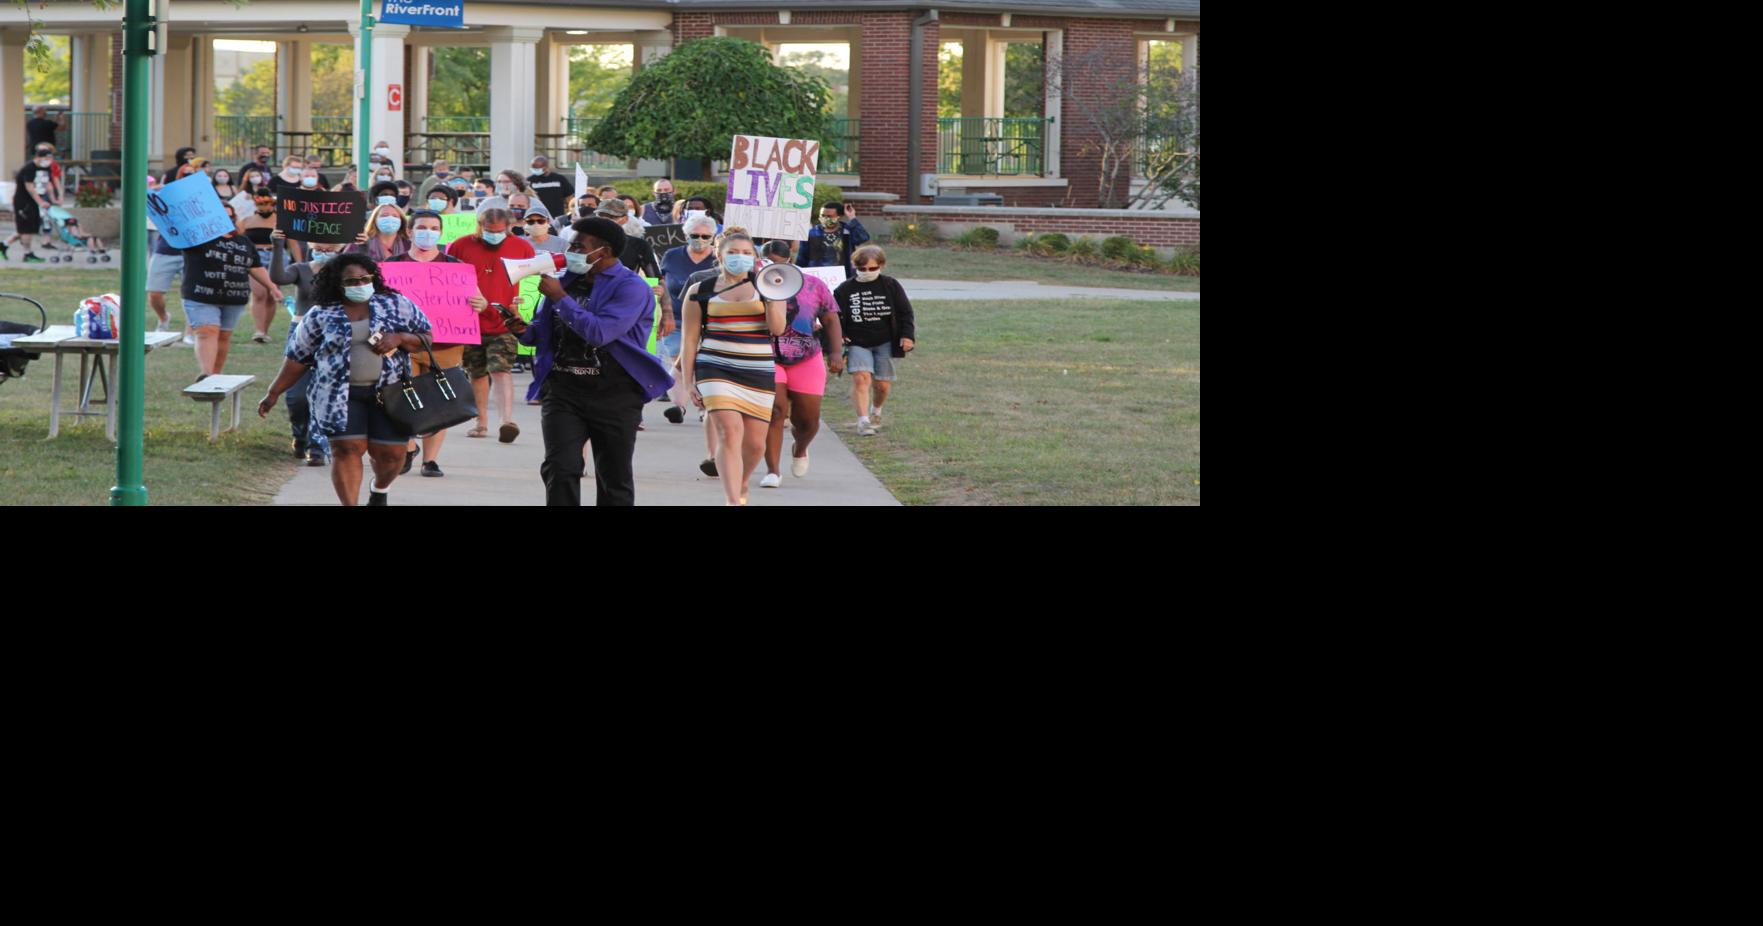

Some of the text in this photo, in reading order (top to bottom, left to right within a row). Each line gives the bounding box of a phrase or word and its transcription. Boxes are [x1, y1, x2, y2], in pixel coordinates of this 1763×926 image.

[385, 3, 460, 16] RiverFront
[388, 88, 401, 106] C
[733, 135, 820, 175] BLACK
[727, 168, 815, 209] LIVES
[283, 199, 354, 214] NO JUSTICE
[292, 218, 343, 235] NO PEACE
[645, 226, 687, 248] ack
[203, 270, 227, 280] VOTE
[429, 264, 469, 287] Rice
[849, 292, 863, 322] Beloit
[434, 316, 478, 337] Bland
